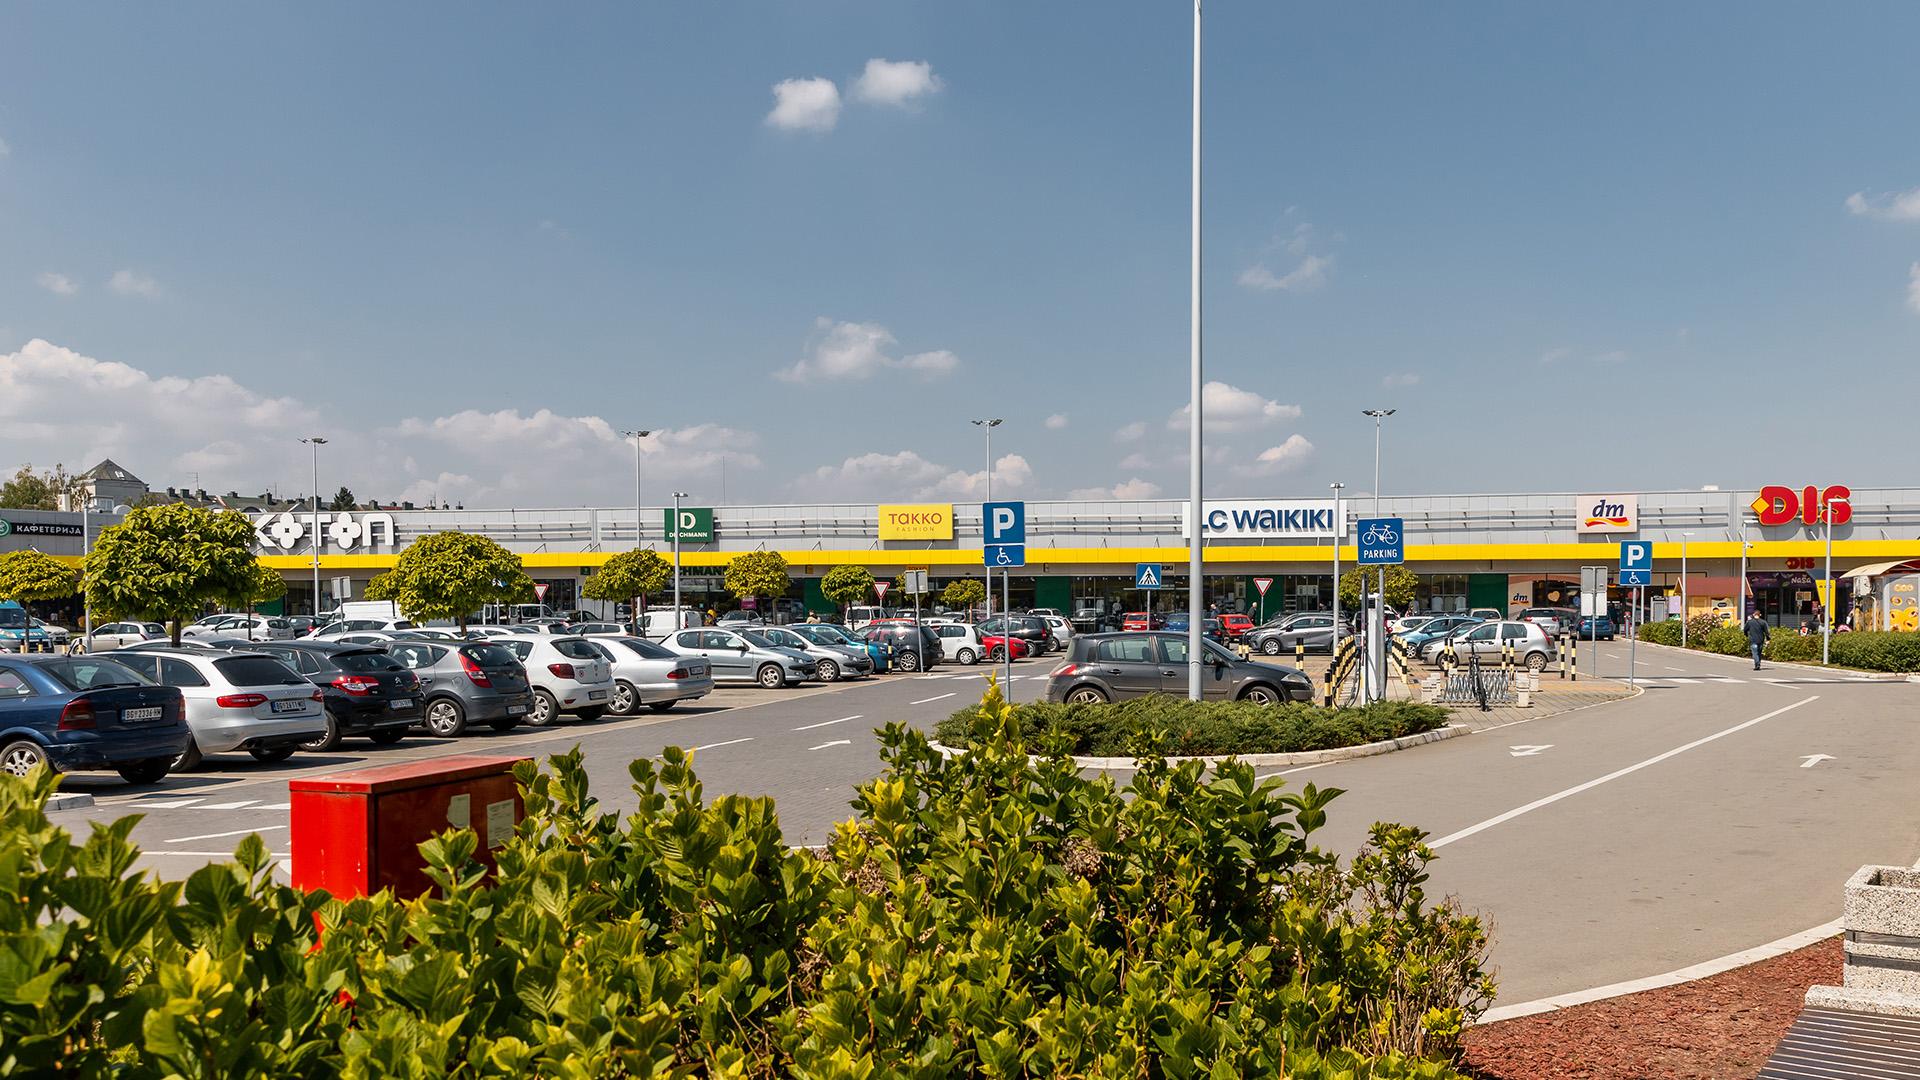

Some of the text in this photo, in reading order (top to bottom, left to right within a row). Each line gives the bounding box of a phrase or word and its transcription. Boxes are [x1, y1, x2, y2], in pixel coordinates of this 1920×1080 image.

[1592, 499, 1625, 518] dm
[1750, 485, 1852, 526] DIS
[16, 524, 82, 534] КАФЕТЕРИЈА
[680, 512, 696, 529] D
[992, 507, 1015, 539] P
[1363, 549, 1398, 559] PARKING
[1627, 544, 1645, 567] P
[1786, 557, 1815, 569] DIS
[1513, 592, 1528, 601] dm
